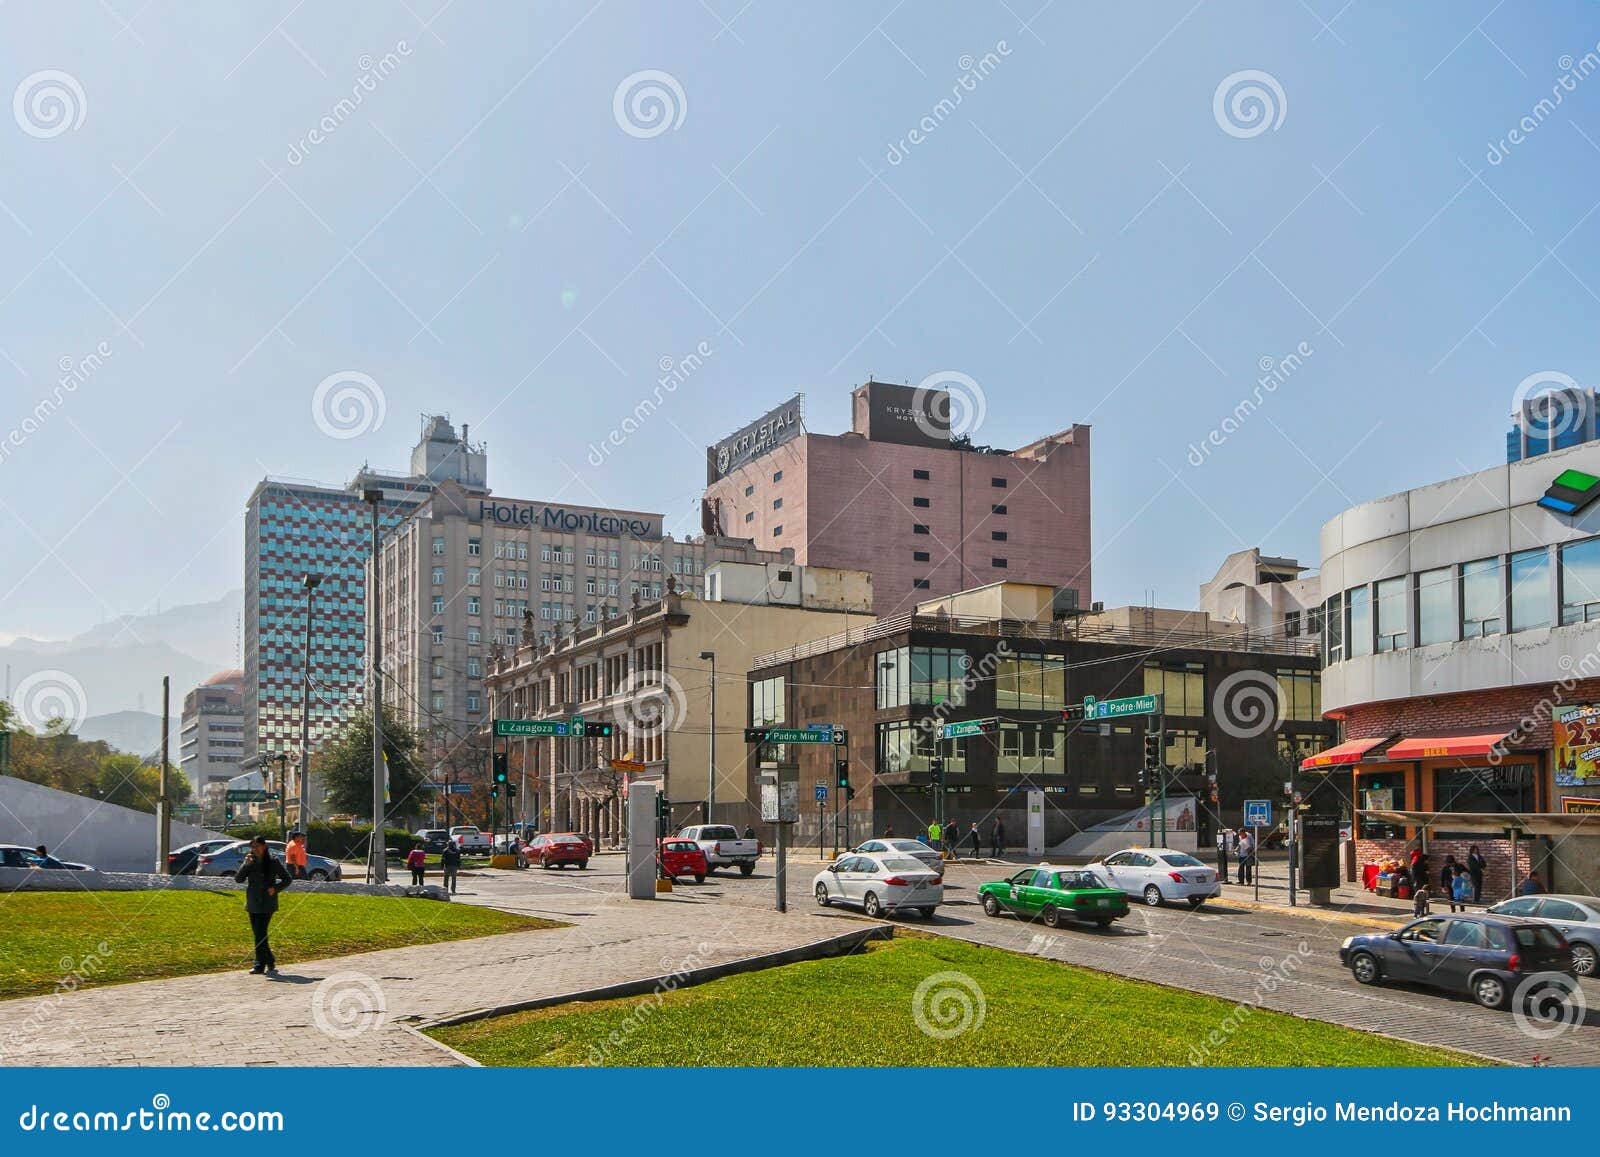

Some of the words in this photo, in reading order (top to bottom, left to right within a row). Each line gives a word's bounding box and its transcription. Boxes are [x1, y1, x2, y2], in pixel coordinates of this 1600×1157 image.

[886, 405, 933, 418] KRYSTAL
[733, 410, 794, 456] KRYSTAL
[749, 437, 777, 457] HOTEL
[479, 500, 535, 525] Hotel
[544, 507, 651, 537] Monterrey
[1110, 702, 1133, 713] Padre
[1135, 699, 1153, 710] Mier
[509, 724, 553, 734] Zaragoza
[773, 732, 797, 741] Padre
[800, 732, 818, 741] Mier
[1423, 747, 1449, 757] BEER
